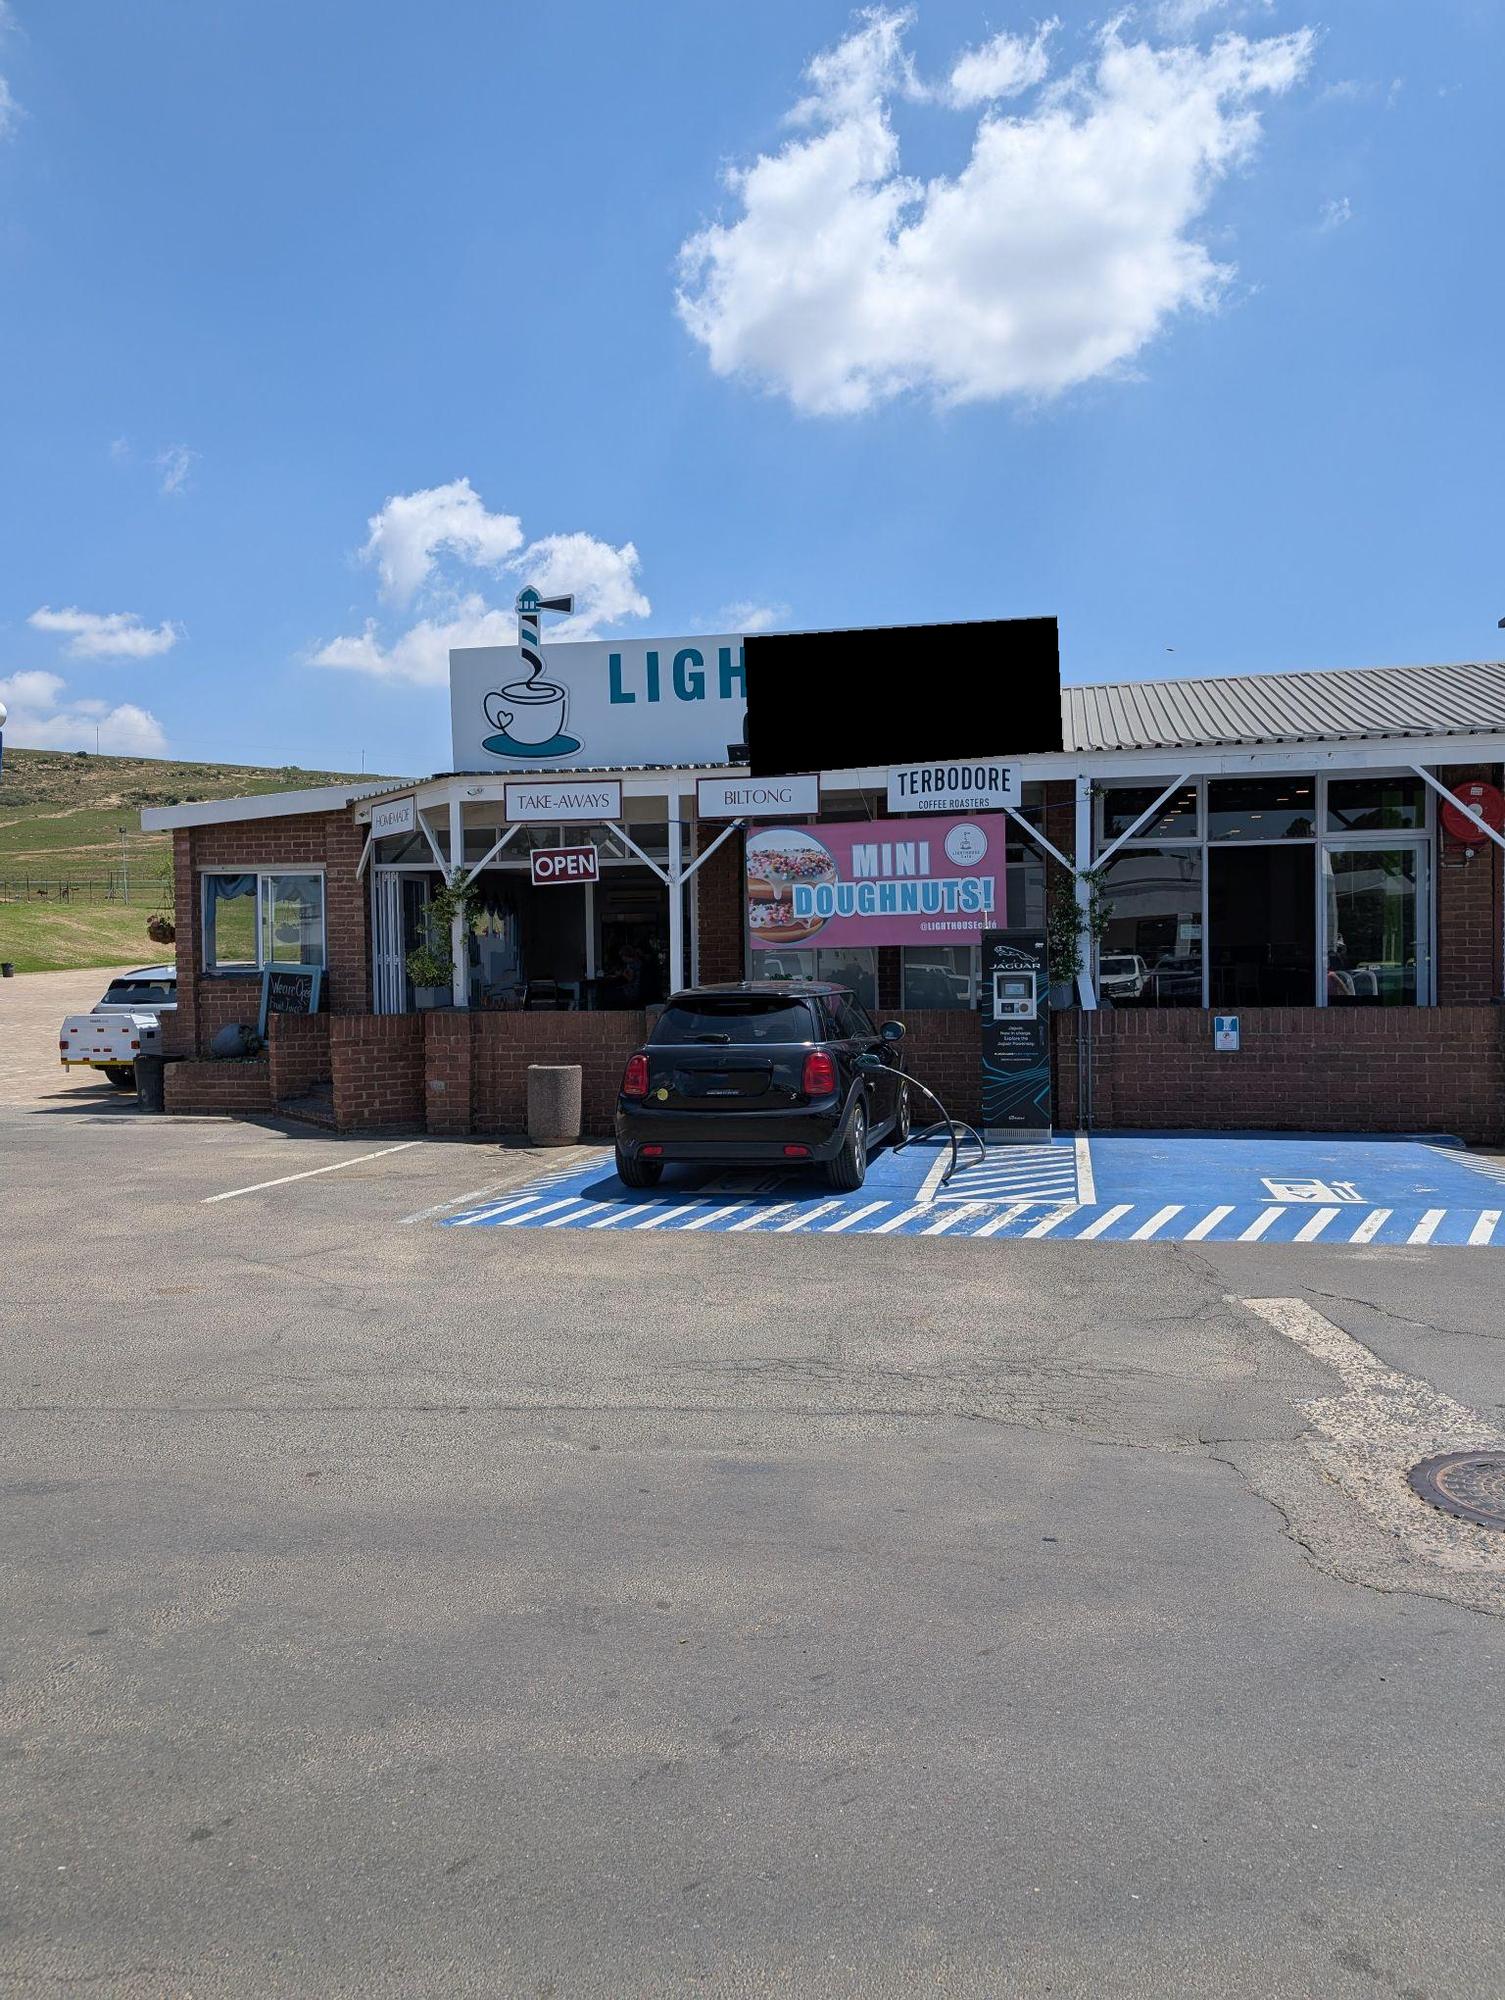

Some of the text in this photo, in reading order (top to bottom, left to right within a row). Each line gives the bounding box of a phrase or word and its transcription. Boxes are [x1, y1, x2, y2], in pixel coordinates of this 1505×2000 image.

[897, 767, 1011, 796] TERBODORE
[518, 793, 610, 810] TAKE-AWAYS
[724, 788, 792, 805] BILTONG
[918, 797, 990, 809] COFFEE ROASTERS
[535, 854, 595, 876] OPEN
[852, 841, 930, 877] MINI
[793, 876, 995, 918] DOUGHNUTS!
